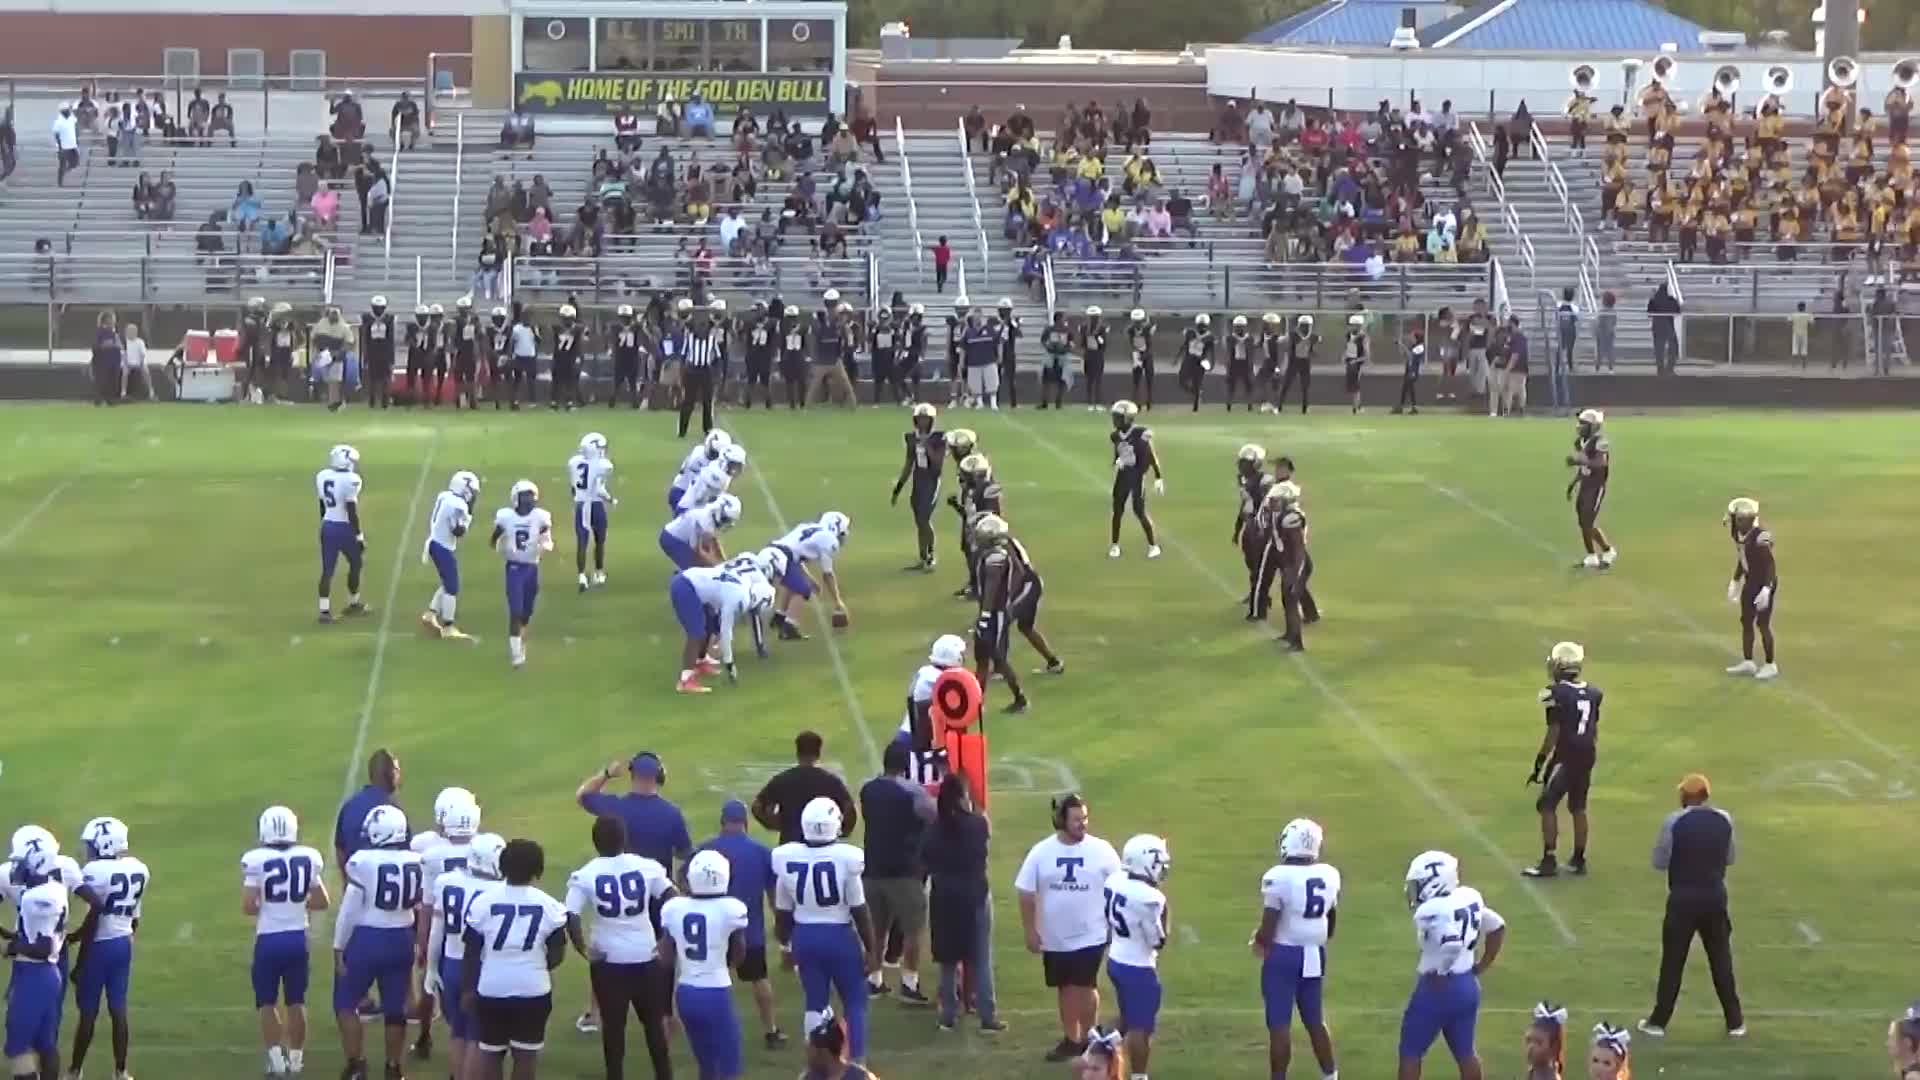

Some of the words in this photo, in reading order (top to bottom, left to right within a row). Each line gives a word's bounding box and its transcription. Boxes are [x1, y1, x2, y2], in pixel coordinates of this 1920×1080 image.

[567, 78, 626, 101] HOME
[626, 79, 653, 101] OF
[656, 79, 698, 101] THE
[697, 80, 776, 102] GOLDEN
[777, 81, 827, 102] BULL
[323, 480, 337, 507] 5
[576, 463, 589, 489] 3
[1577, 699, 1591, 735] 7
[263, 855, 312, 903] 20
[375, 863, 422, 911] 60
[786, 860, 839, 907] 70
[1056, 857, 1084, 882] T
[595, 870, 646, 917] 99
[1303, 877, 1326, 919] 6
[490, 903, 544, 952] 77
[683, 912, 708, 961] 9
